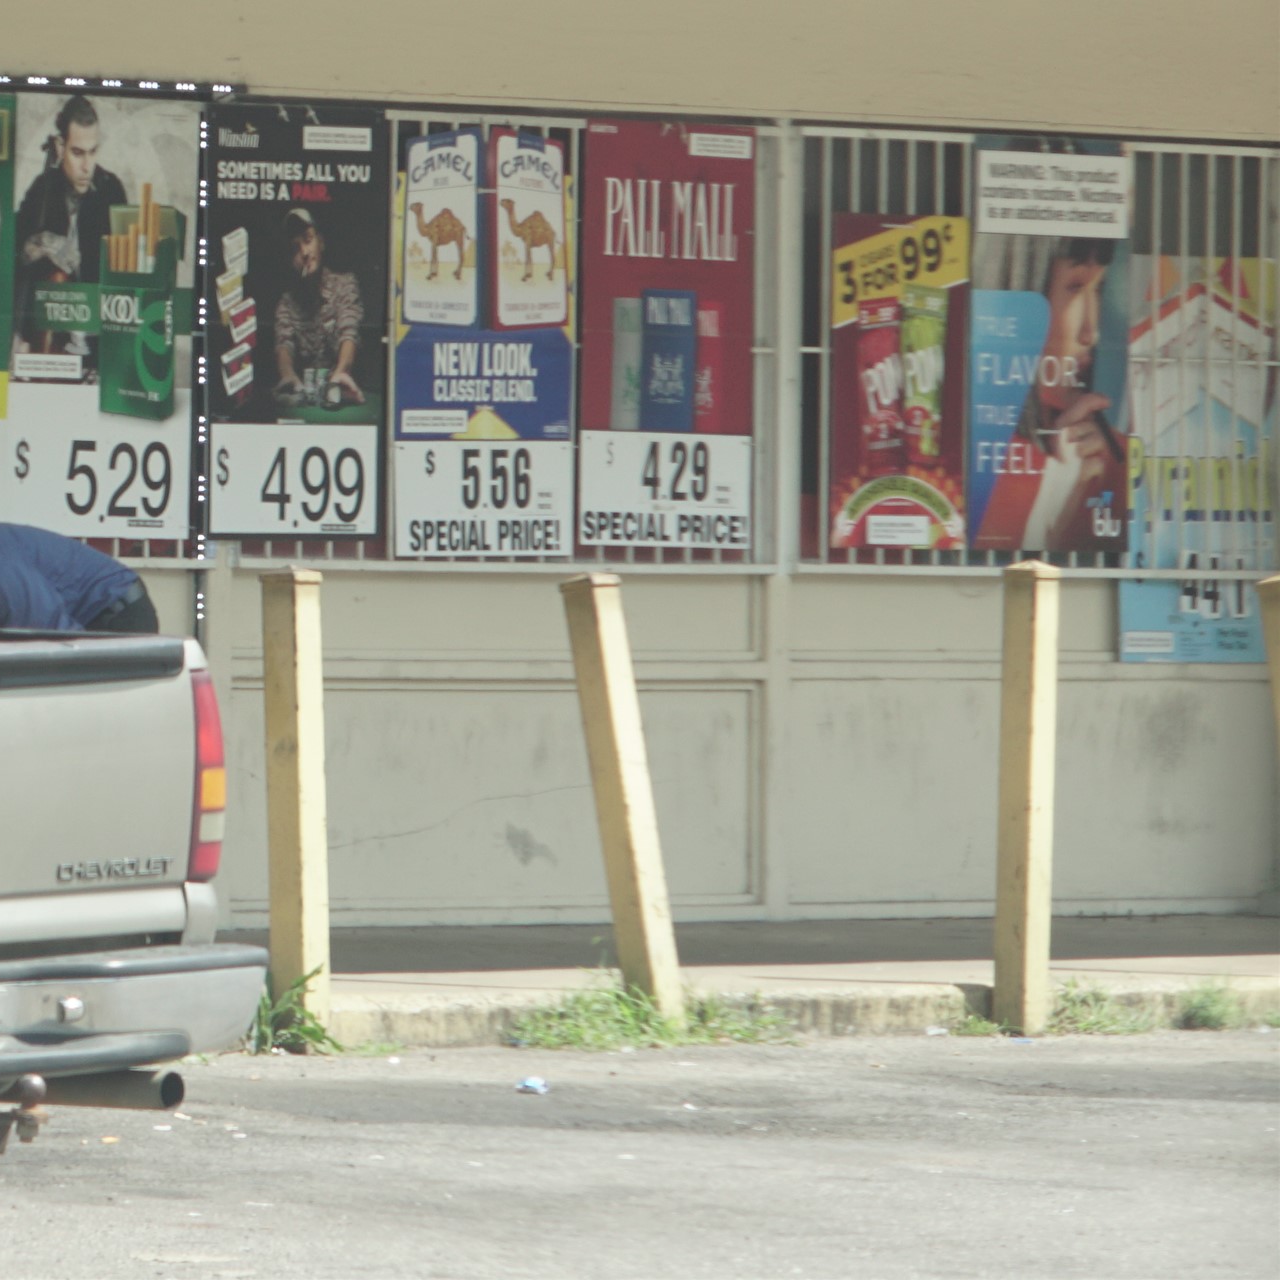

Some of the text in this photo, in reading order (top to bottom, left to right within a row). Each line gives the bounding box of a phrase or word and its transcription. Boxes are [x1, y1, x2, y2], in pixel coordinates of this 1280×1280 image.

[218, 127, 260, 148] Winston
[217, 160, 371, 183] SOMETIMES ALL YOU
[411, 153, 473, 184] CAMEL
[500, 155, 561, 190] CAMEL
[217, 182, 257, 200] NEED
[260, 183, 275, 200] IS
[277, 184, 290, 200] A
[603, 177, 738, 261] PALL MALL
[838, 260, 857, 304] 3
[862, 262, 898, 295] FOR
[45, 303, 91, 323] TREND
[100, 293, 144, 324] KOOL
[434, 343, 537, 377] NEW LOOK.
[976, 352, 1085, 388] FLAVOR.
[433, 379, 537, 402] CLASSIC BLEND.
[641, 441, 709, 502] 4.29
[976, 442, 1043, 475] FEEL.
[14, 438, 172, 524] $ 5.29
[216, 445, 365, 527] $ 4.99
[425, 449, 436, 476] $
[462, 448, 532, 510] 5.56
[409, 519, 561, 552] SPECIAL PRICE!
[582, 510, 748, 545] SPECIAL PRICE!
[1092, 507, 1122, 537] blu
[57, 857, 174, 883] CHEVROLET
